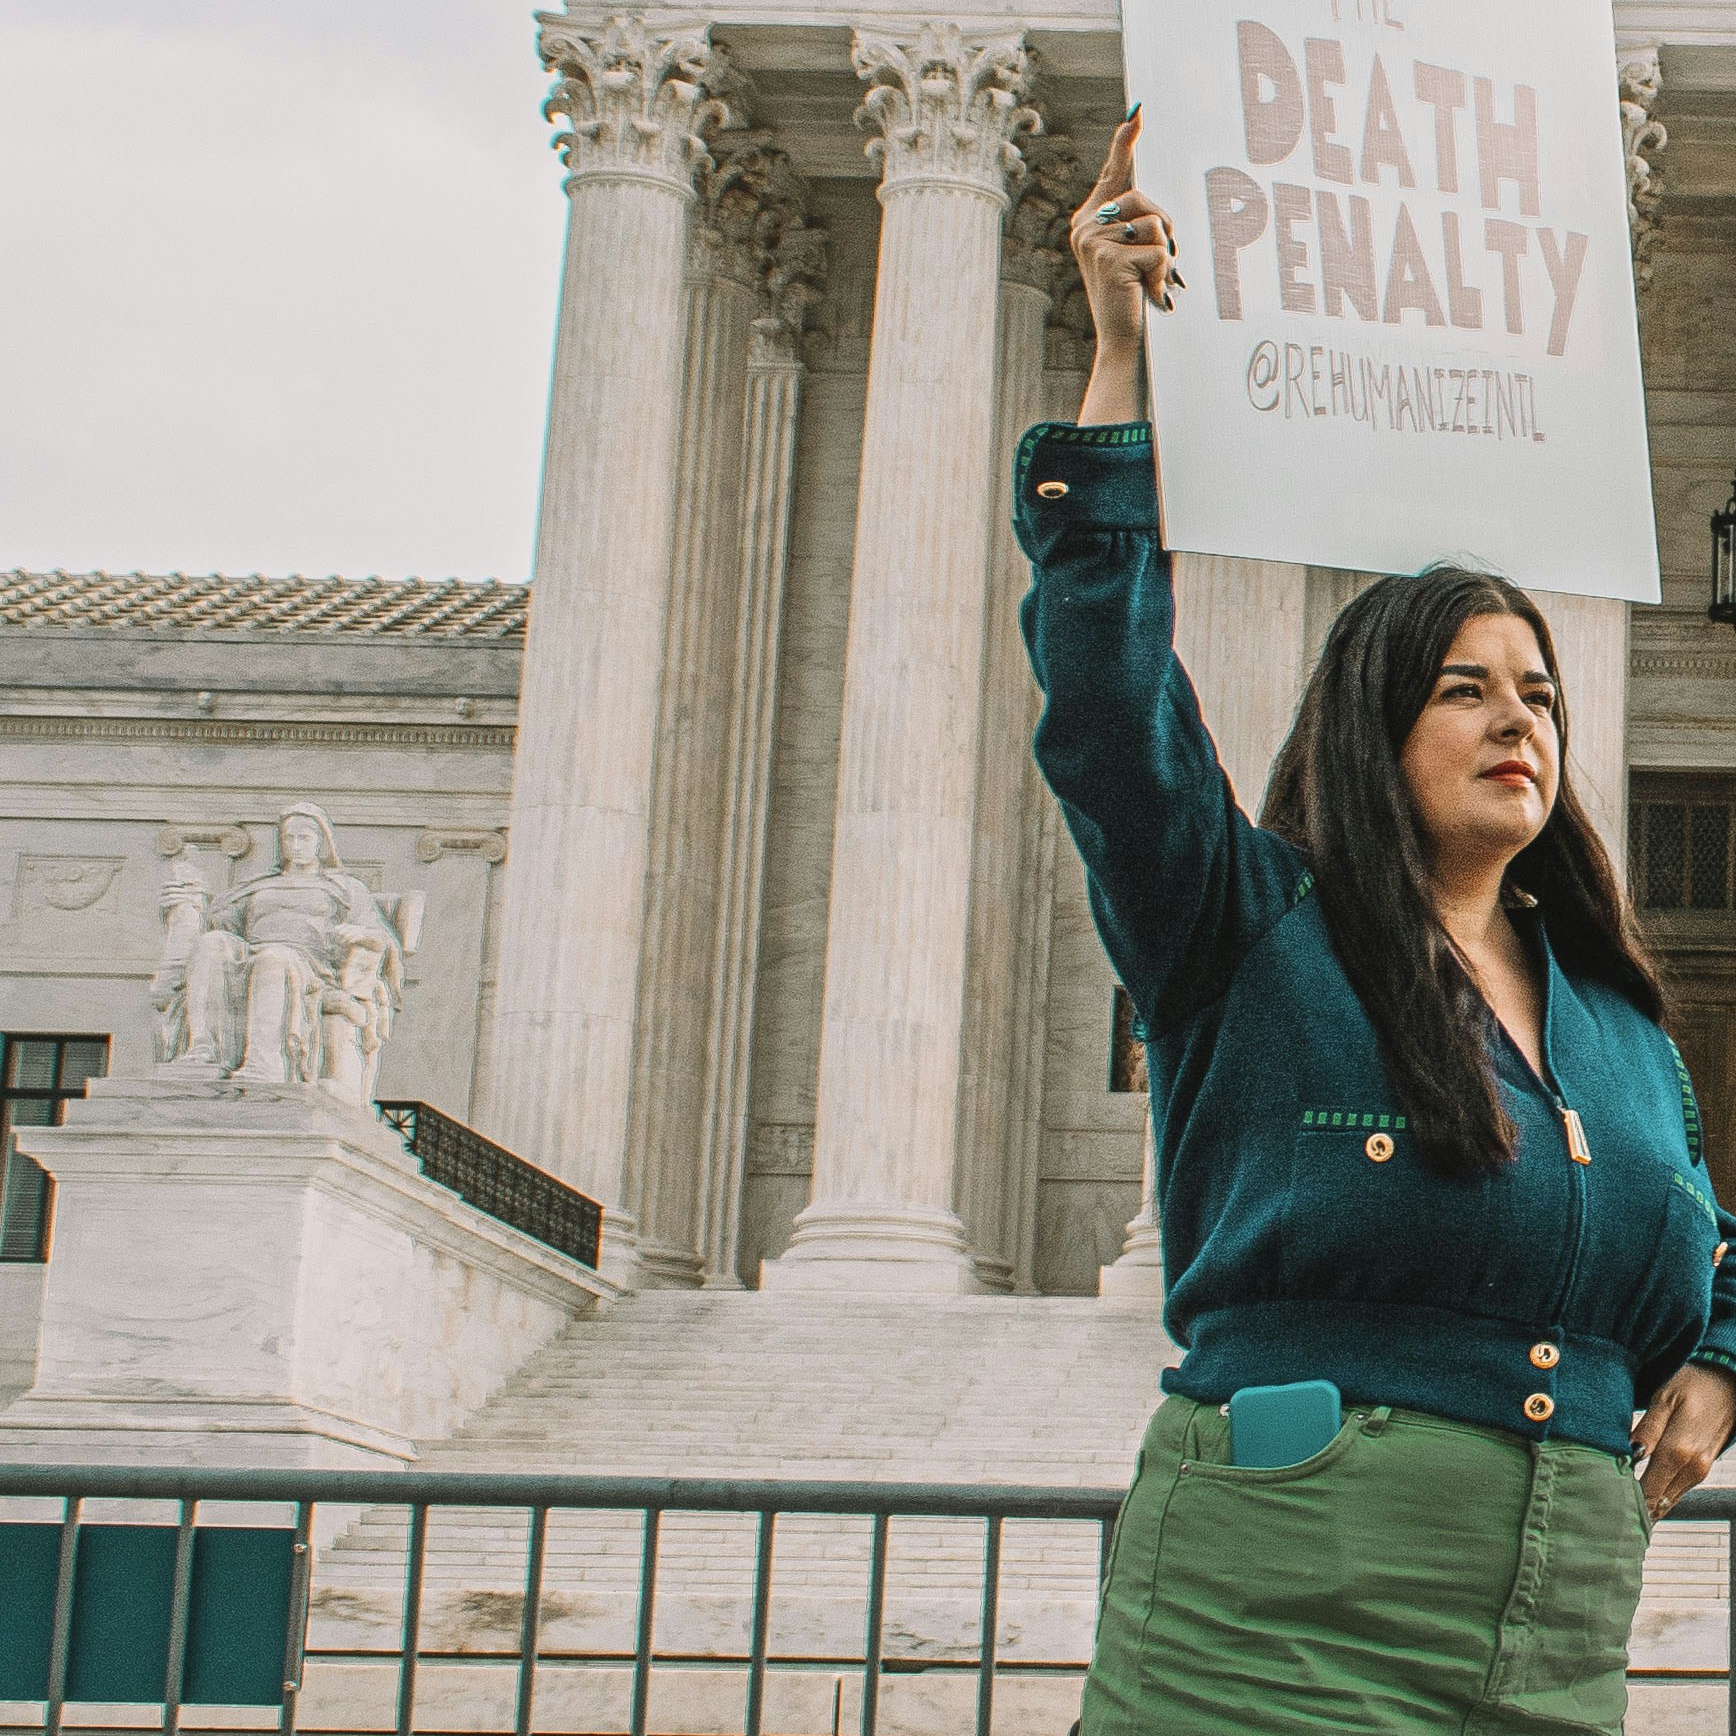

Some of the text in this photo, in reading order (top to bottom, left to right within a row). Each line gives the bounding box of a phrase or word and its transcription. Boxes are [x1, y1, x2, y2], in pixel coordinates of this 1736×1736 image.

[1236, 19, 1541, 218] DEATH
[1204, 166, 1590, 358] PENALTY
[1247, 339, 1546, 443] @REHUMANIZEINTL
